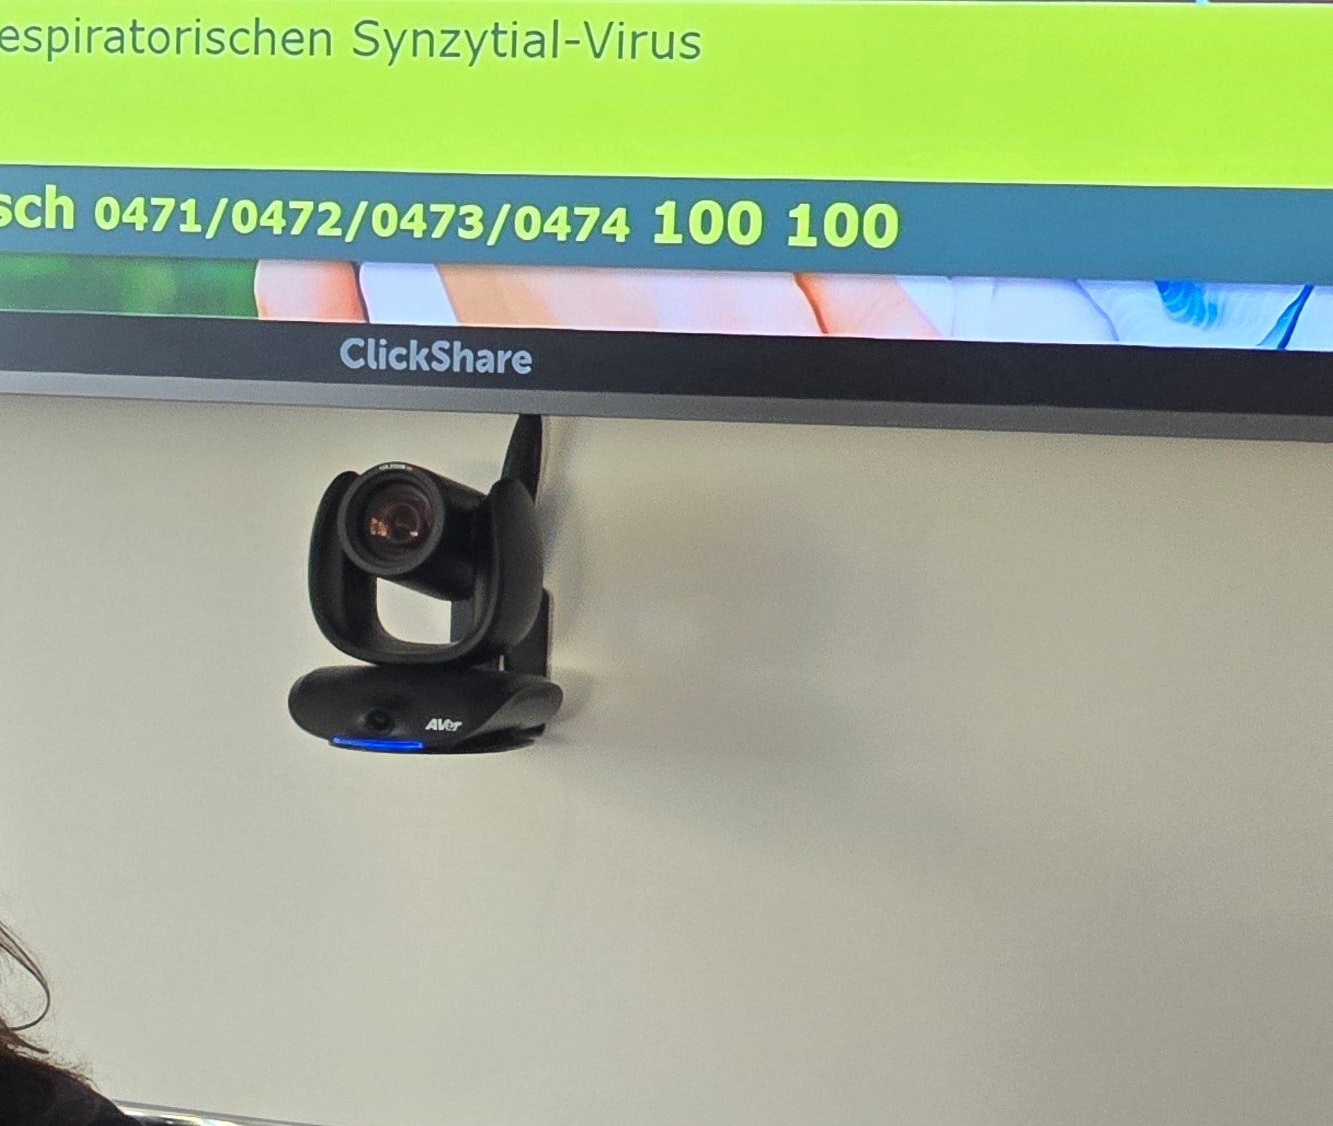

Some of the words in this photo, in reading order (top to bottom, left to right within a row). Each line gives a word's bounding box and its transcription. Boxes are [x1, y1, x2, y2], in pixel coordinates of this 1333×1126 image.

[351, 18, 703, 66] Synzytial-Virus
[94, 196, 631, 244] 0471/0472/0473/0474
[653, 199, 763, 247] 100
[786, 202, 899, 250] 100
[339, 337, 533, 377] ClickShare
